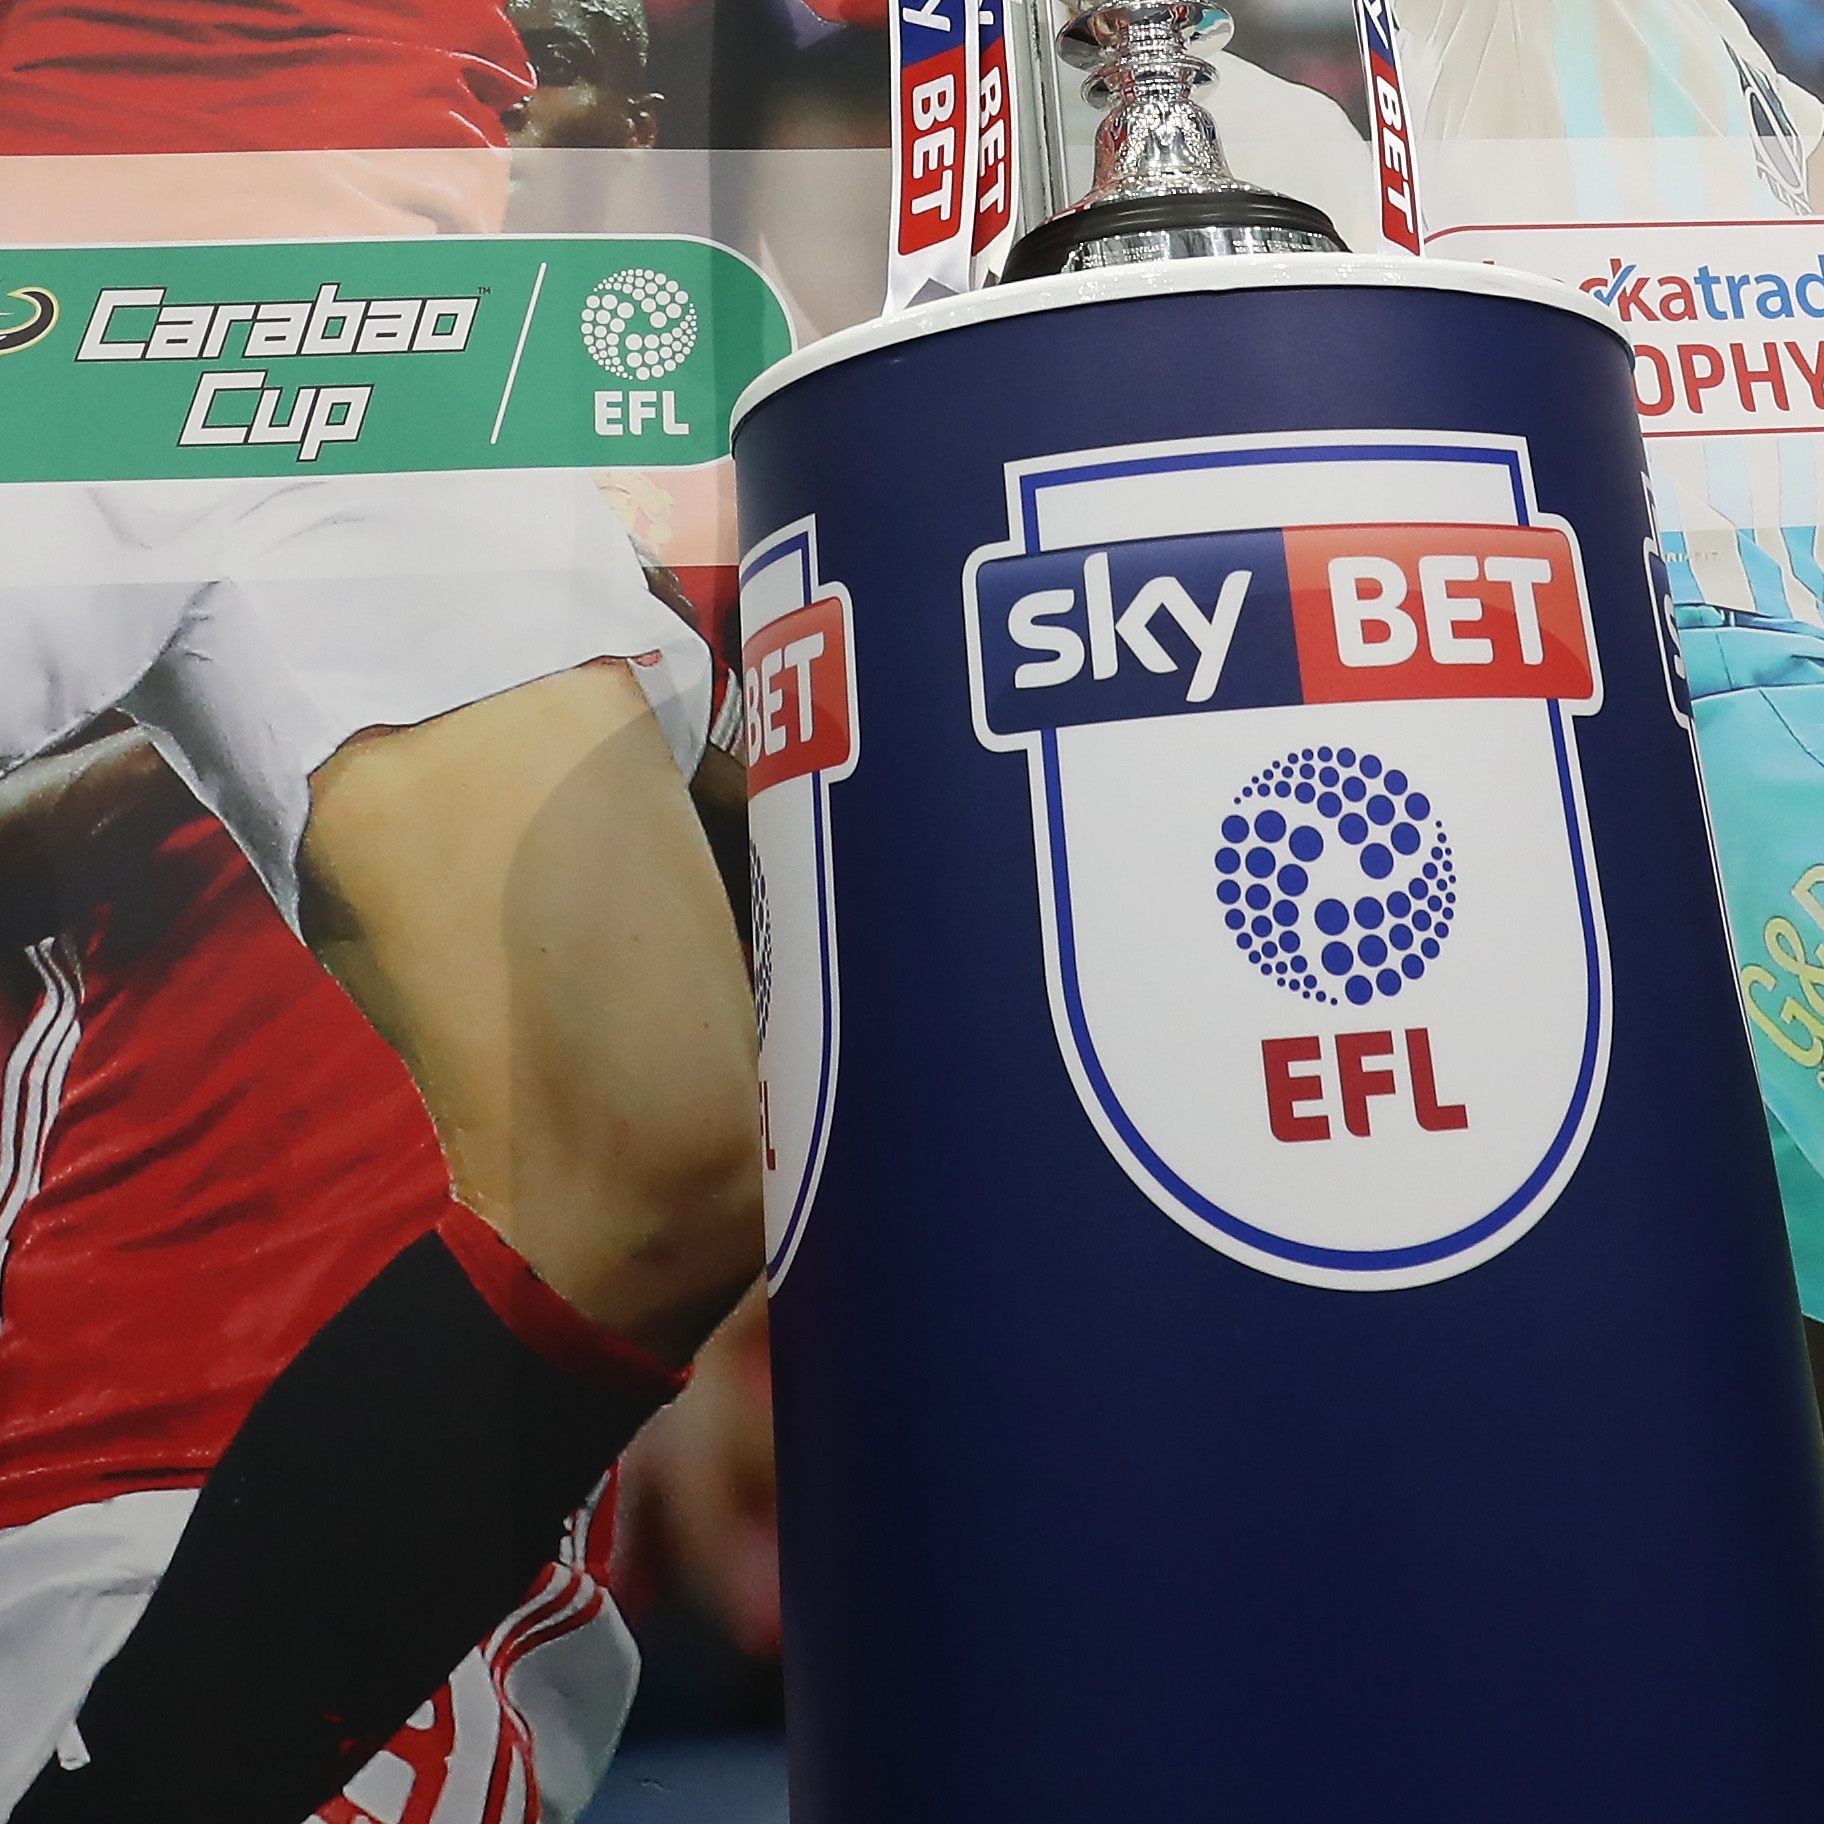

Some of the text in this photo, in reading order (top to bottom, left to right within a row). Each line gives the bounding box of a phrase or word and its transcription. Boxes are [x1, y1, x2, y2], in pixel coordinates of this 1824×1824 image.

[910, 72, 956, 222] BET
[1376, 74, 1416, 236] BET
[74, 283, 477, 361] Carabao
[176, 369, 373, 463] Cup
[594, 389, 690, 438] EFL
[1005, 551, 1252, 704] sky
[1327, 552, 1553, 669] BET
[746, 632, 824, 767] BET
[1260, 1026, 1469, 1143] EFL
